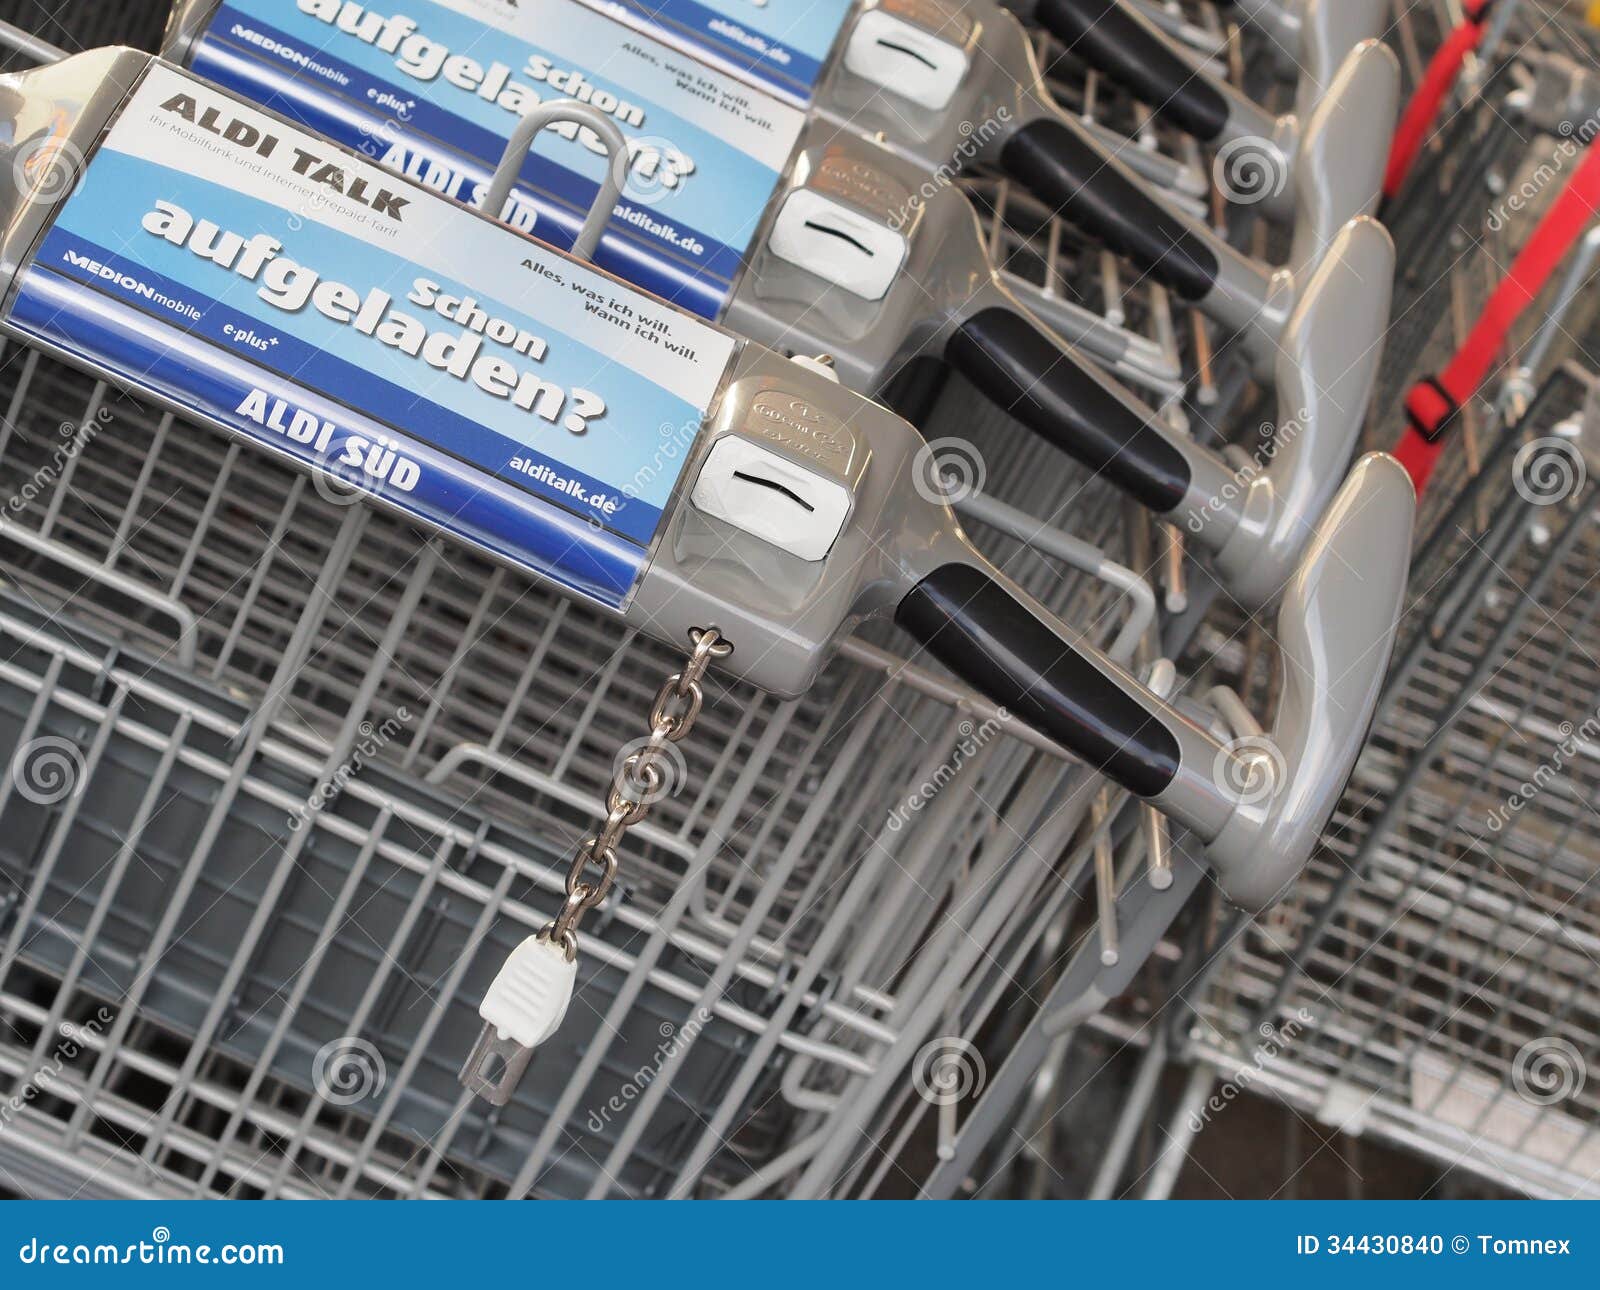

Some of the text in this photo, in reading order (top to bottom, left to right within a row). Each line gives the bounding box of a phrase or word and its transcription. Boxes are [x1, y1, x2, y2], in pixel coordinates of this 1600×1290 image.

[523, 54, 645, 126] Schon
[622, 42, 751, 110] Alles, was ich will.
[676, 78, 774, 132] Wann ich will.
[149, 114, 169, 129] Ihr
[159, 92, 411, 223] ALDI TALK
[380, 143, 465, 199] ALDI
[613, 204, 704, 256] alditalk.de
[141, 198, 606, 433] aufgeladen?
[407, 277, 549, 361] Schon
[519, 258, 672, 337] Alles, was ich will.
[584, 301, 699, 363] Wann ich will.
[235, 388, 421, 492] ALDI SÜD
[508, 455, 616, 515] alditalk.de
